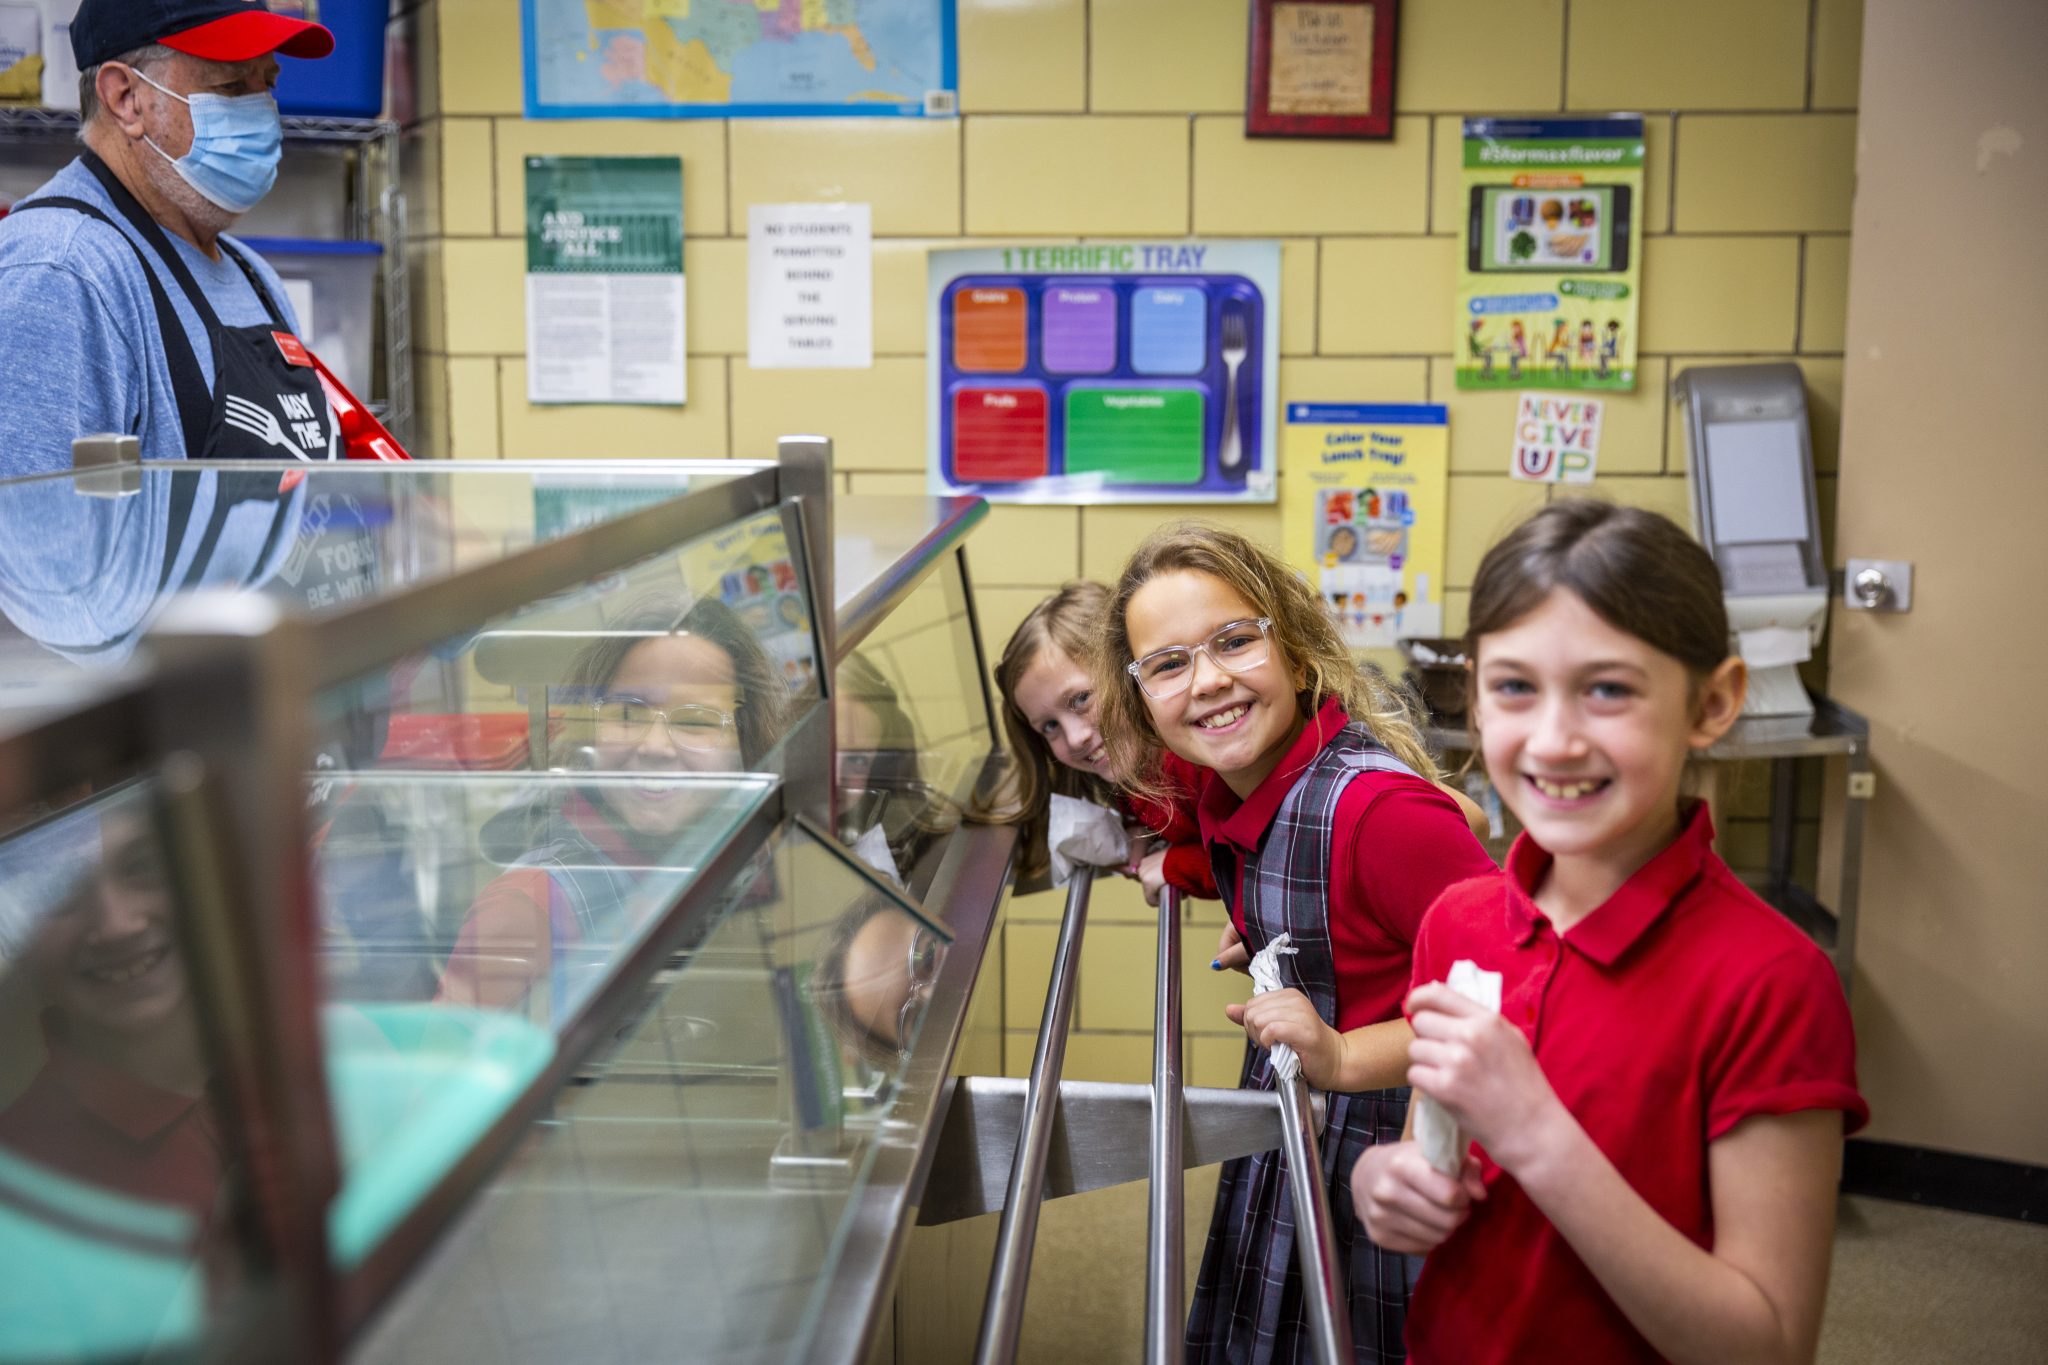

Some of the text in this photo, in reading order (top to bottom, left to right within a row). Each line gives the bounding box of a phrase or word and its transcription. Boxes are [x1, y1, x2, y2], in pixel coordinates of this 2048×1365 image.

[542, 211, 584, 225] AND
[541, 227, 622, 243] JUSTICE
[765, 224, 851, 236] NO STUDENTS
[563, 241, 600, 257] ALL
[773, 246, 844, 258] PERMITTED
[1018, 246, 1134, 270] TERRIFIC
[1141, 246, 1206, 269] TRAY
[786, 269, 832, 281] BEHIND
[798, 292, 821, 303] THE
[783, 315, 836, 326] SERVING
[788, 338, 832, 348] TABLES
[277, 392, 315, 420] MAY
[1104, 394, 1164, 408] Vegetables
[1523, 399, 1597, 423] NEVER
[290, 420, 327, 449] THE
[1325, 431, 1403, 446] Color Your
[1519, 421, 1592, 449] GIVE
[1321, 449, 1362, 465] Lunch
[1519, 447, 1591, 480] UP
[306, 583, 335, 609] BE
